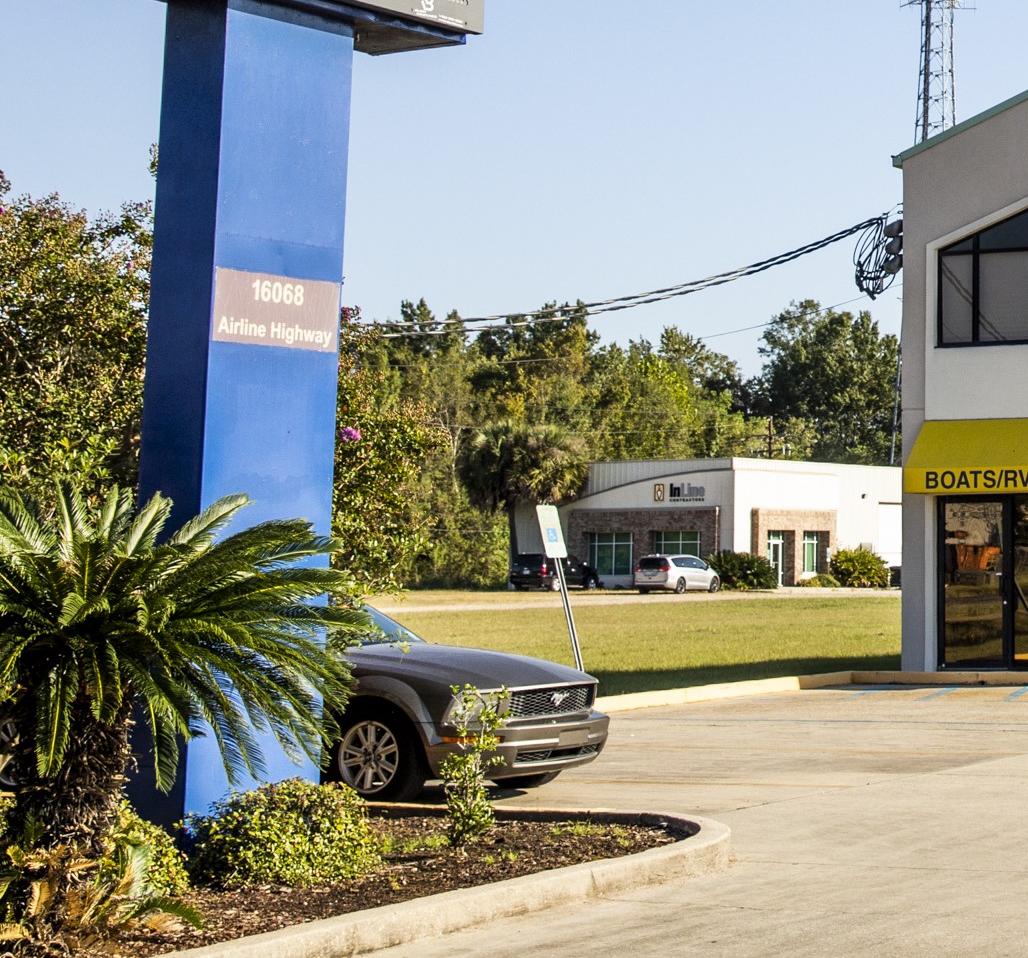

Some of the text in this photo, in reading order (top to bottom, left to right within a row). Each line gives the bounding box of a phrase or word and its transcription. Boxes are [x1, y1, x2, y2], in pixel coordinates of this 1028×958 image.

[252, 279, 304, 306] 16068
[217, 316, 332, 348] Airline Highway
[669, 483, 705, 497] InLine
